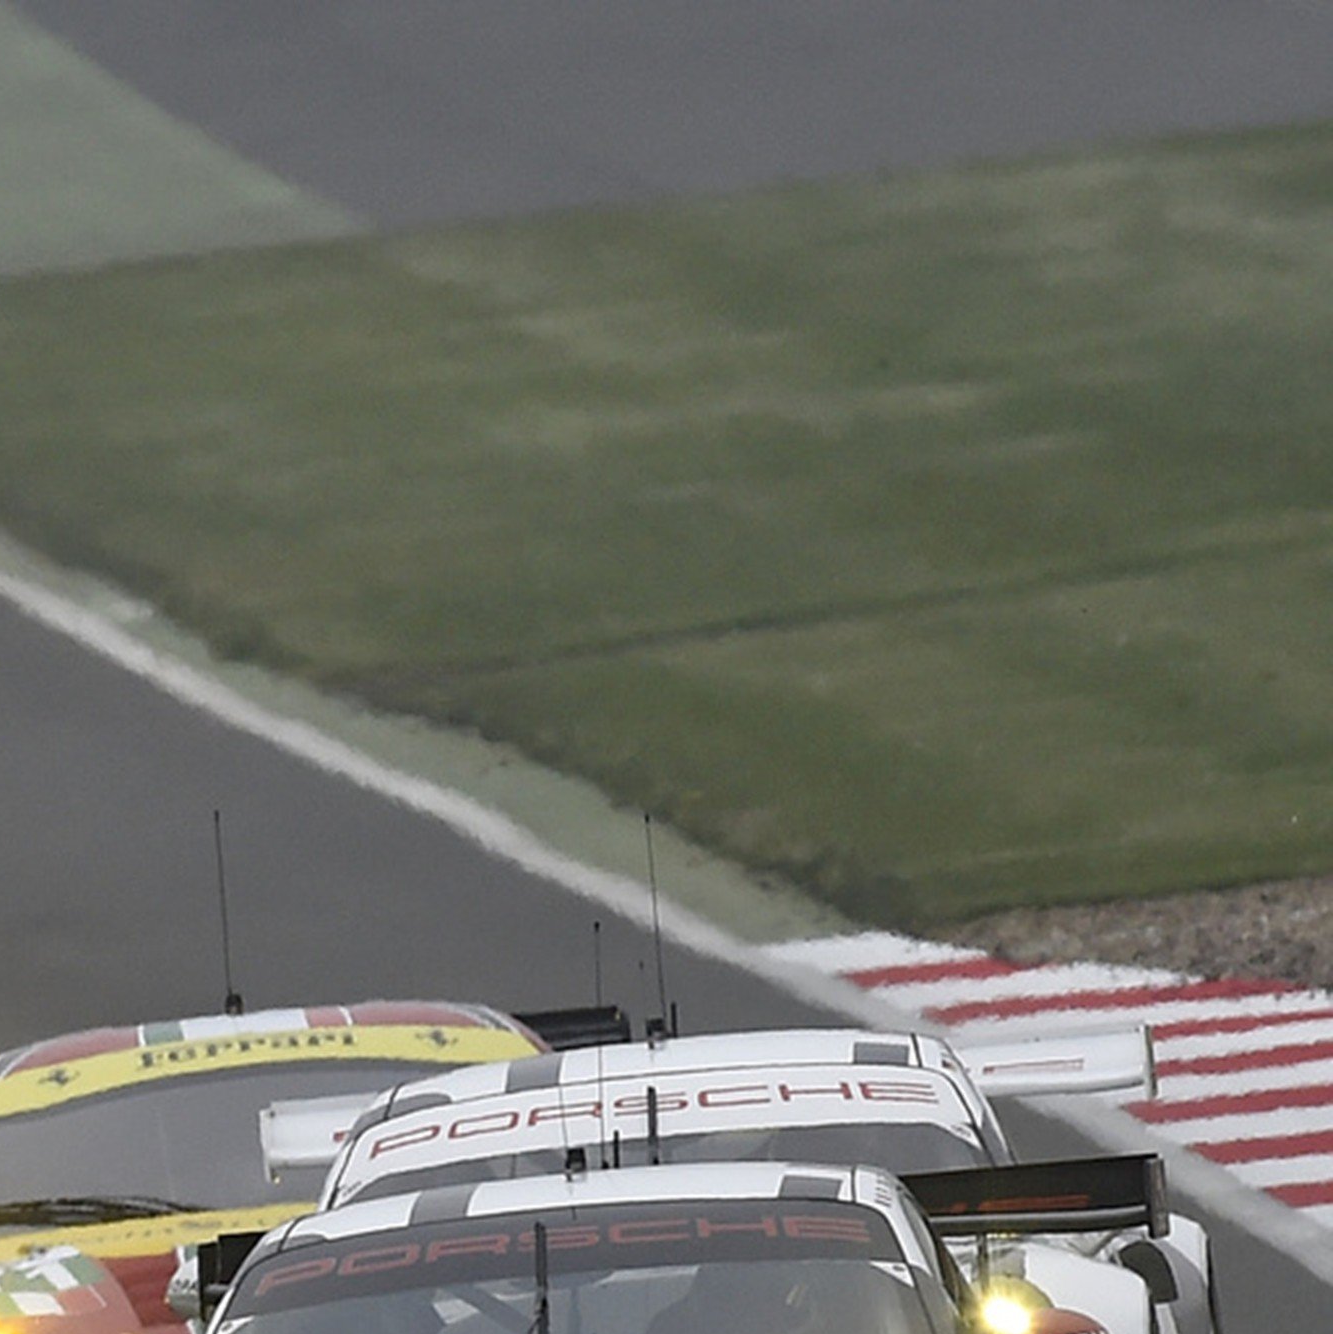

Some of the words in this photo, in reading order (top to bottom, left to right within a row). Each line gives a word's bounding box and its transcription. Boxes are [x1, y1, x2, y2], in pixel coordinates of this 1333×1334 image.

[140, 1030, 355, 1069] Ferrari
[369, 1079, 940, 1160] PORSCHE
[253, 1214, 874, 1296] PORSCHE
